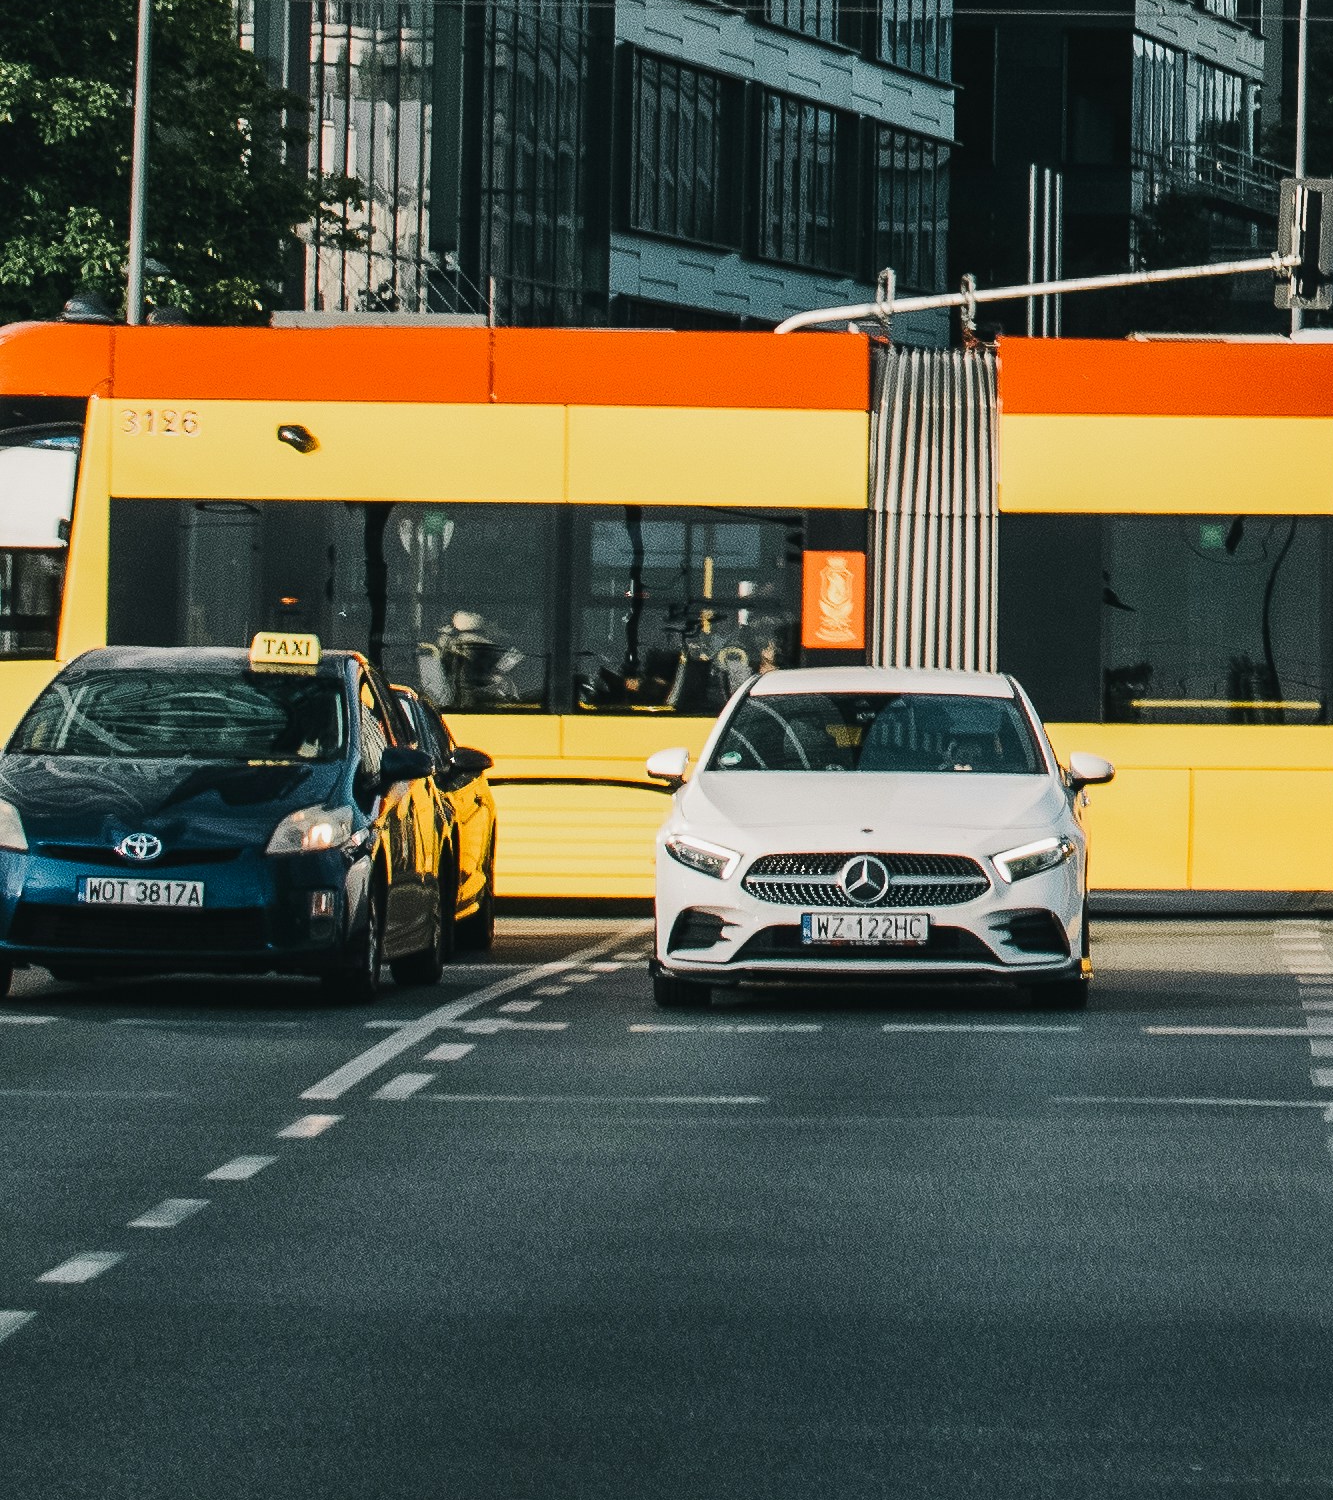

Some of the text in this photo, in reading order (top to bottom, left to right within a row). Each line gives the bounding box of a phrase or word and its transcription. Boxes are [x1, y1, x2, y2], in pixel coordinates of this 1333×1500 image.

[120, 408, 199, 437] 3126
[263, 638, 312, 657] TAXI
[89, 880, 129, 903] WOT
[136, 881, 200, 906] 3817A
[817, 916, 845, 939] WZ
[856, 916, 921, 939] 122HC
